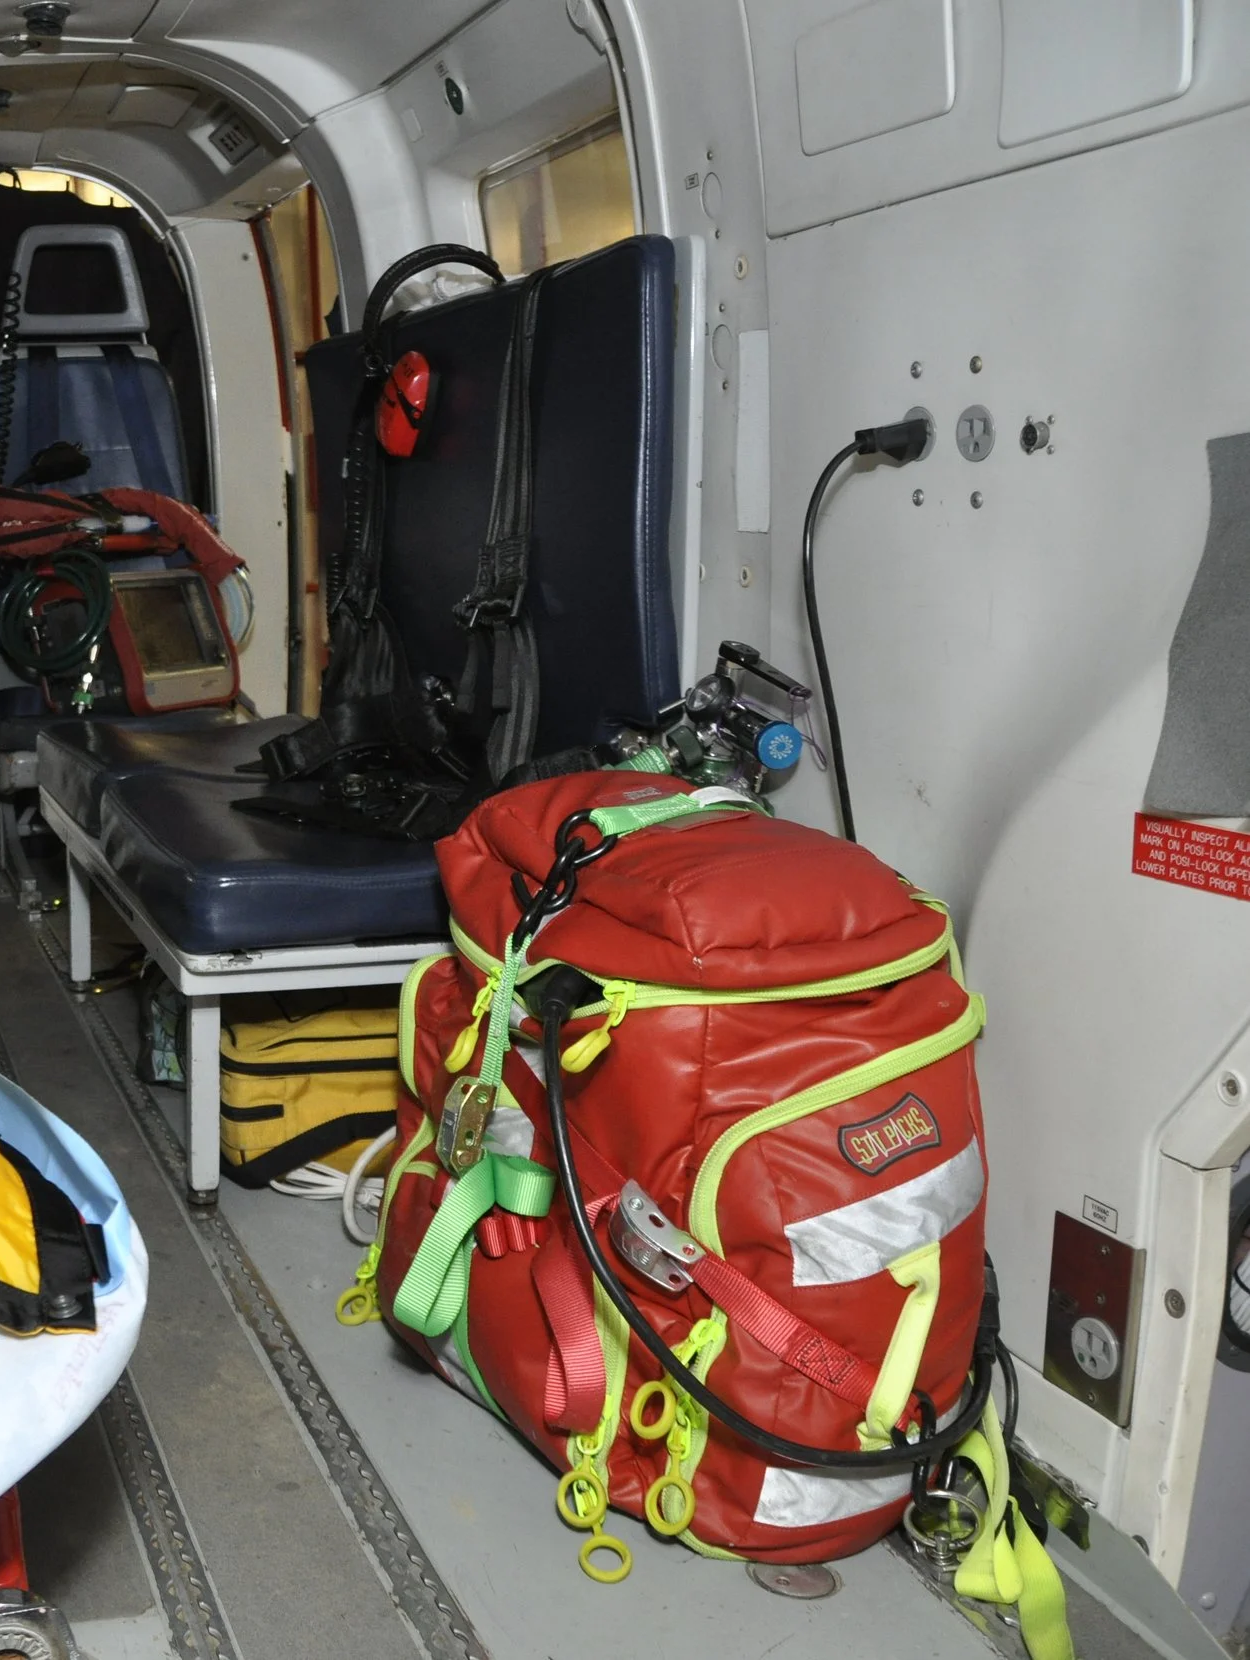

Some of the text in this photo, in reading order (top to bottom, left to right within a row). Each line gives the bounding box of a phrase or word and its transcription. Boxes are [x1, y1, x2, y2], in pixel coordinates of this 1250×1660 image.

[1140, 833, 1163, 848] MARK
[1167, 839, 1180, 852] ON
[1183, 842, 1235, 864] POSI-LOCK
[1145, 821, 1188, 839] VISUALLY
[1191, 830, 1230, 848] INSPECT
[1136, 859, 1165, 876] LOWER
[1169, 867, 1205, 885] PLATES
[1209, 876, 1237, 893] PRIOR
[1149, 849, 1166, 862] AND
[1170, 853, 1220, 874] POSI-LOCK
[851, 1107, 932, 1164] STAT PACKS
